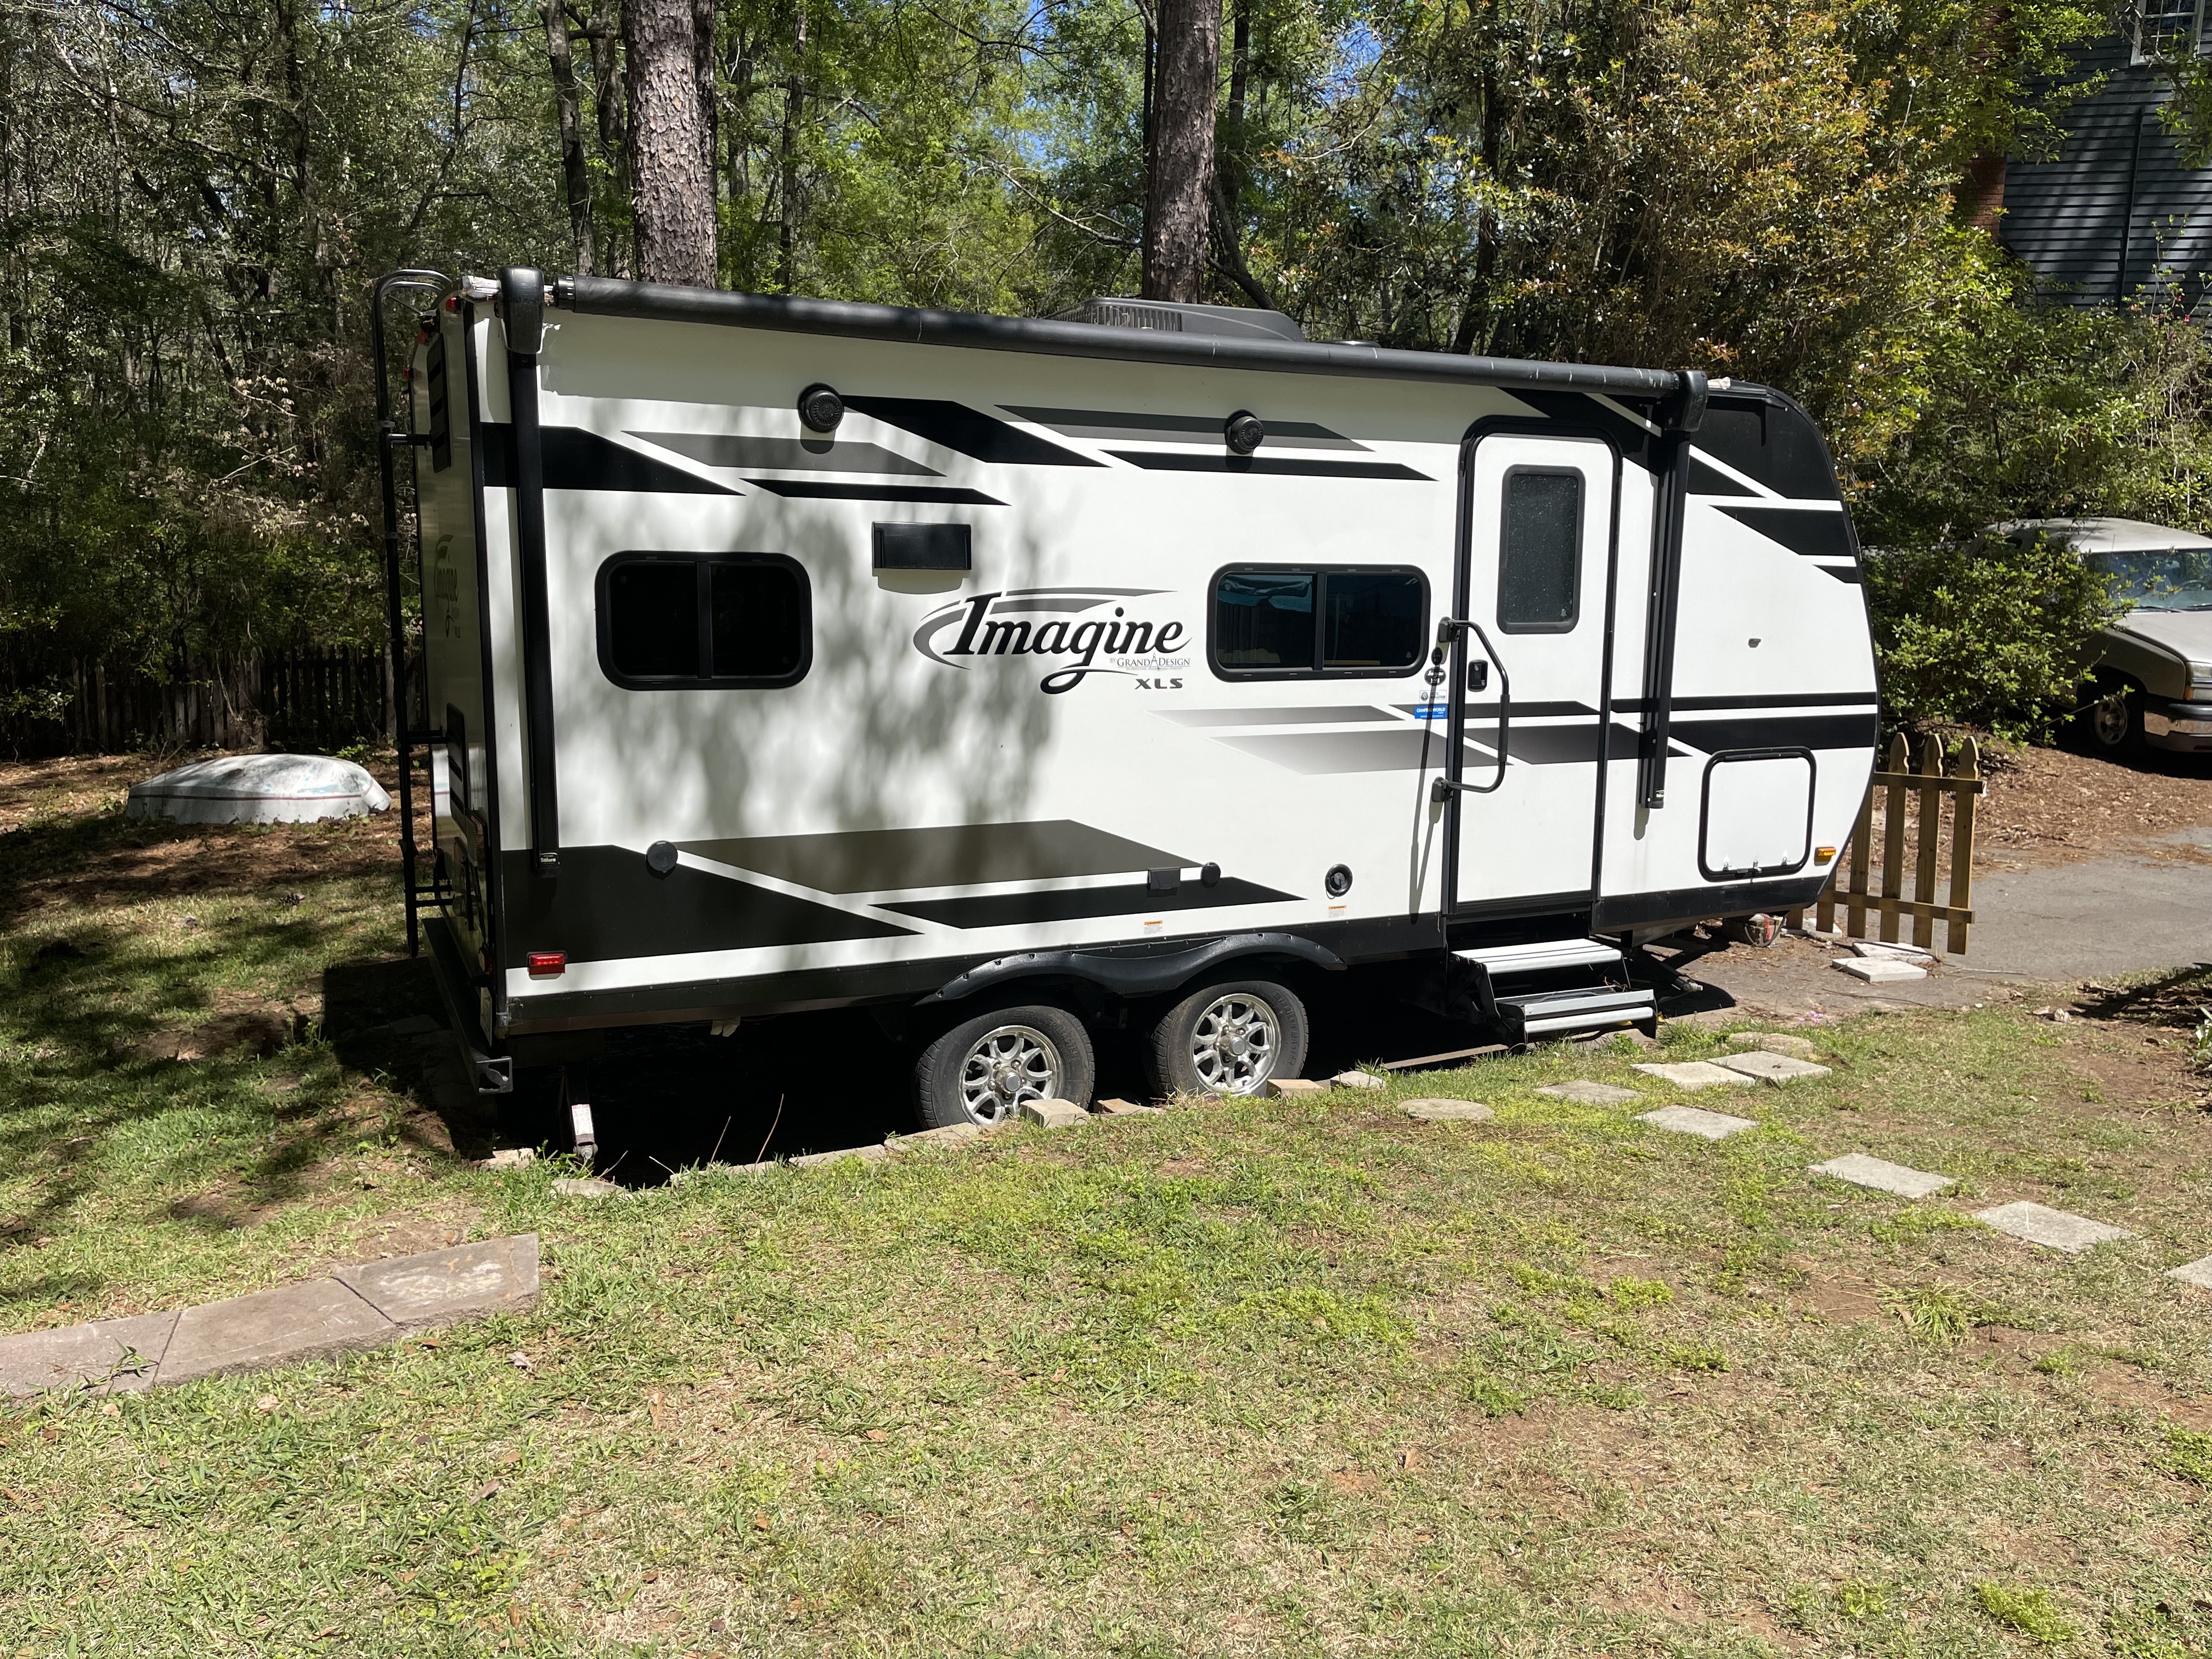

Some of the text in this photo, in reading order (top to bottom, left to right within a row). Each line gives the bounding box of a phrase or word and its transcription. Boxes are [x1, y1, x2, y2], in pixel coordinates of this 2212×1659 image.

[942, 591, 1193, 695] Imagine
[1117, 657, 1150, 666] GRAND
[1159, 657, 1190, 666] DESIGN
[1135, 678, 1183, 690] XLS
